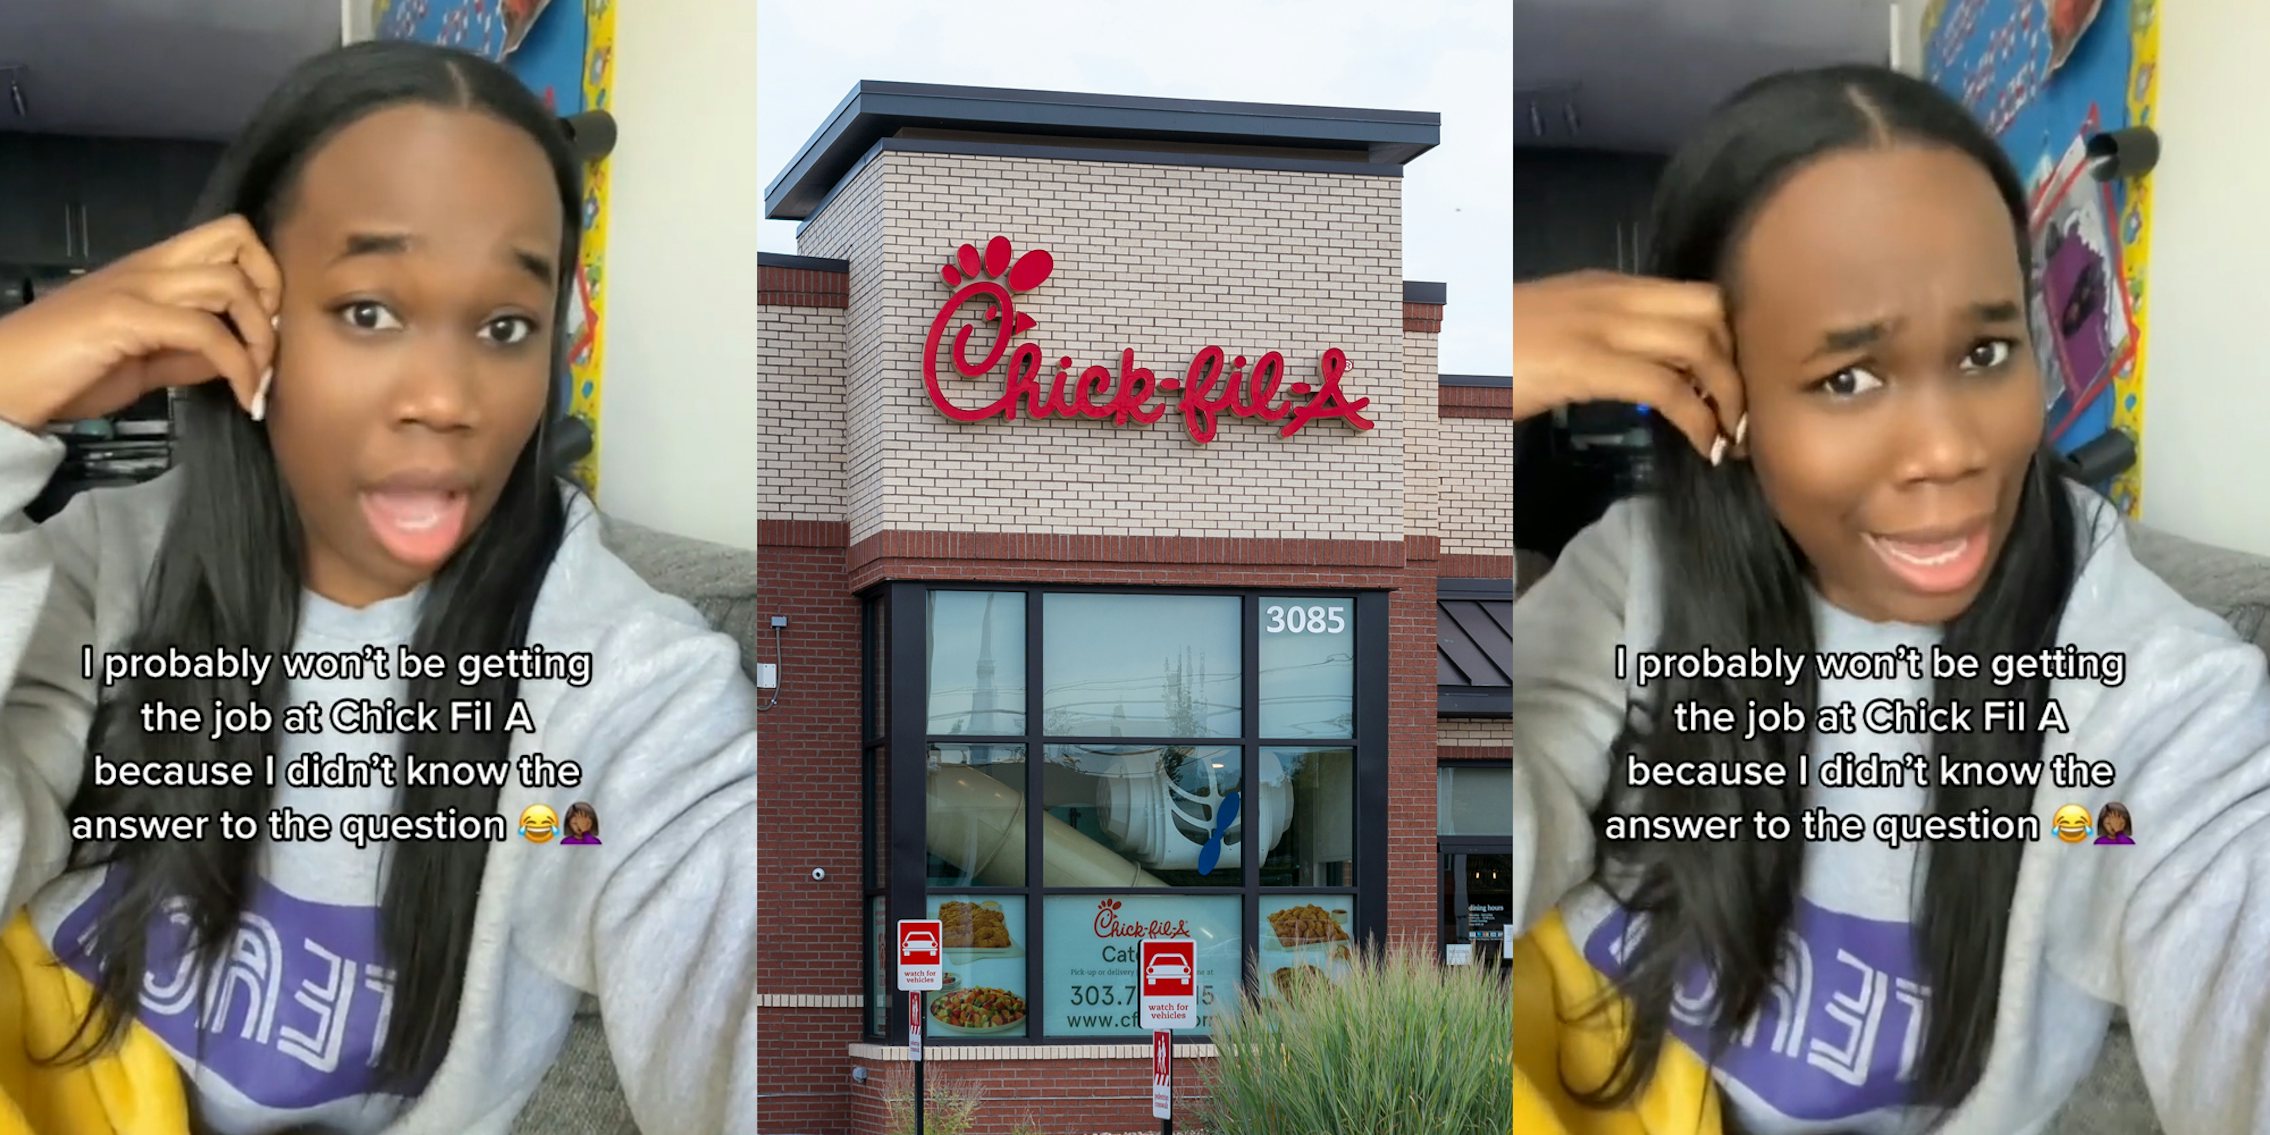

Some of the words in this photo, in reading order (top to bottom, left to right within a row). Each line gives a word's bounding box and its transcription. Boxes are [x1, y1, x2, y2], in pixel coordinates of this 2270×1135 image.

[923, 281, 1374, 444] Chick-fil-A
[1266, 605, 1345, 633] 3085
[1094, 908, 1190, 939] Chick-fil-A
[1070, 968, 1096, 977] Pick-up
[1107, 968, 1135, 977] delivery
[1148, 1003, 1175, 1011] watch
[1176, 1003, 1189, 1011] for
[1151, 1011, 1186, 1019] vehicles
